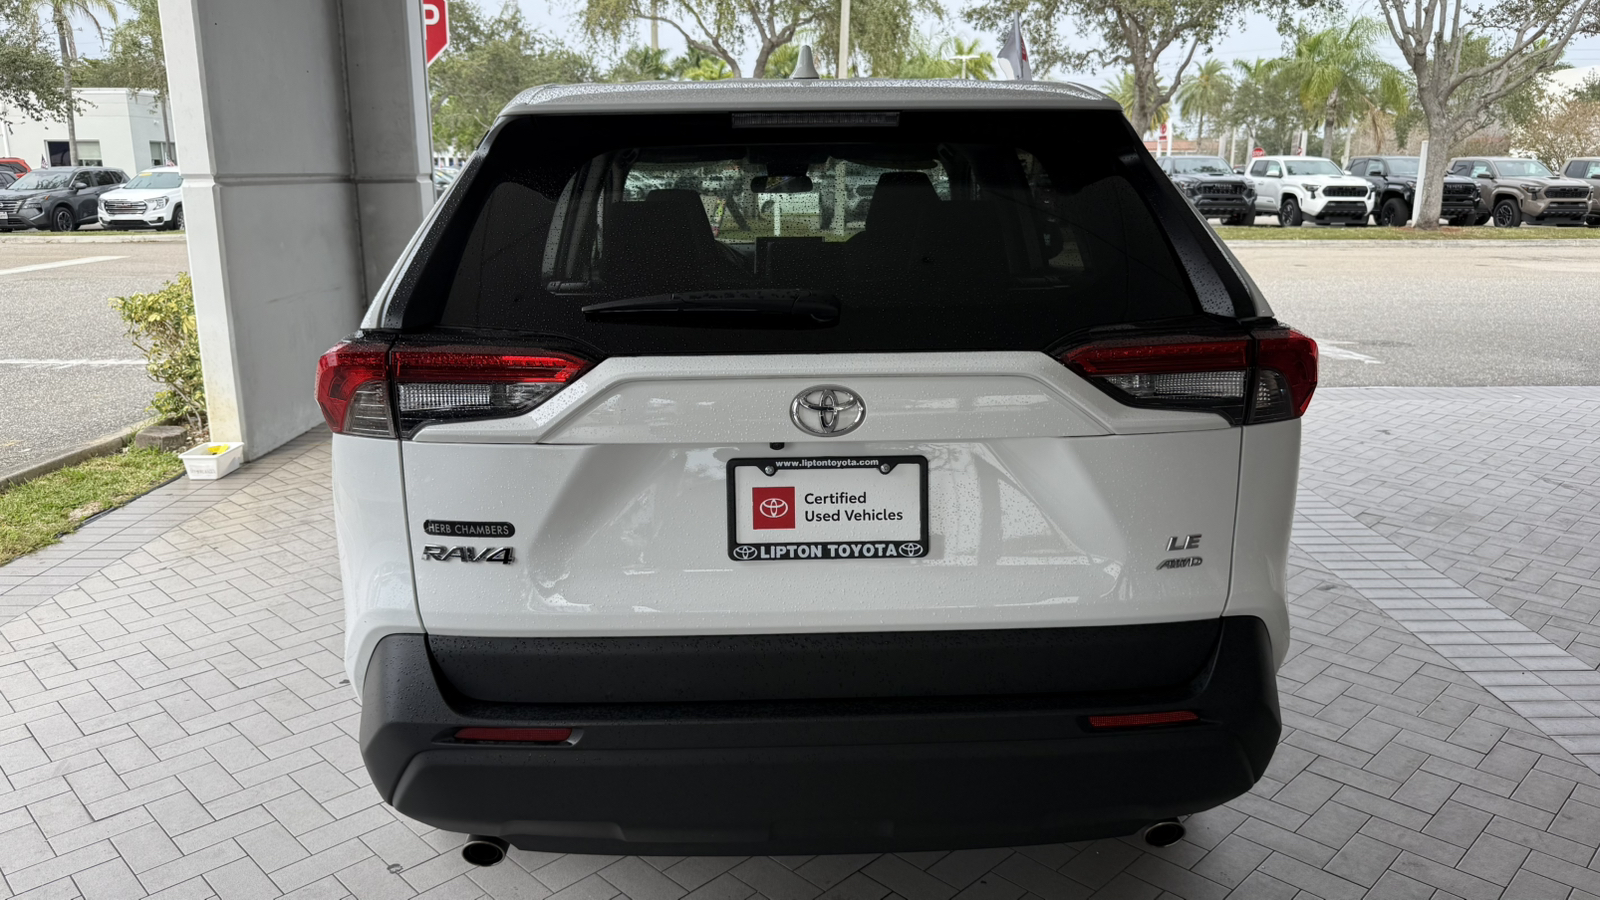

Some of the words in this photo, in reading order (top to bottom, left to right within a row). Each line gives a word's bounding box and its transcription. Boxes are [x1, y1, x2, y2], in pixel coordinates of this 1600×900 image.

[775, 459, 879, 468] www.liptontoyota.com
[804, 492, 867, 505] Certified
[804, 510, 840, 522] Used
[844, 509, 904, 522] Vehicles
[427, 523, 451, 534] HERB
[454, 524, 509, 535] CHAMBERS
[1165, 534, 1203, 552] LE
[421, 543, 515, 565] RAV4
[760, 545, 822, 559] LIPTON
[827, 544, 898, 558] TOYOTA
[1155, 556, 1203, 571] AWD
